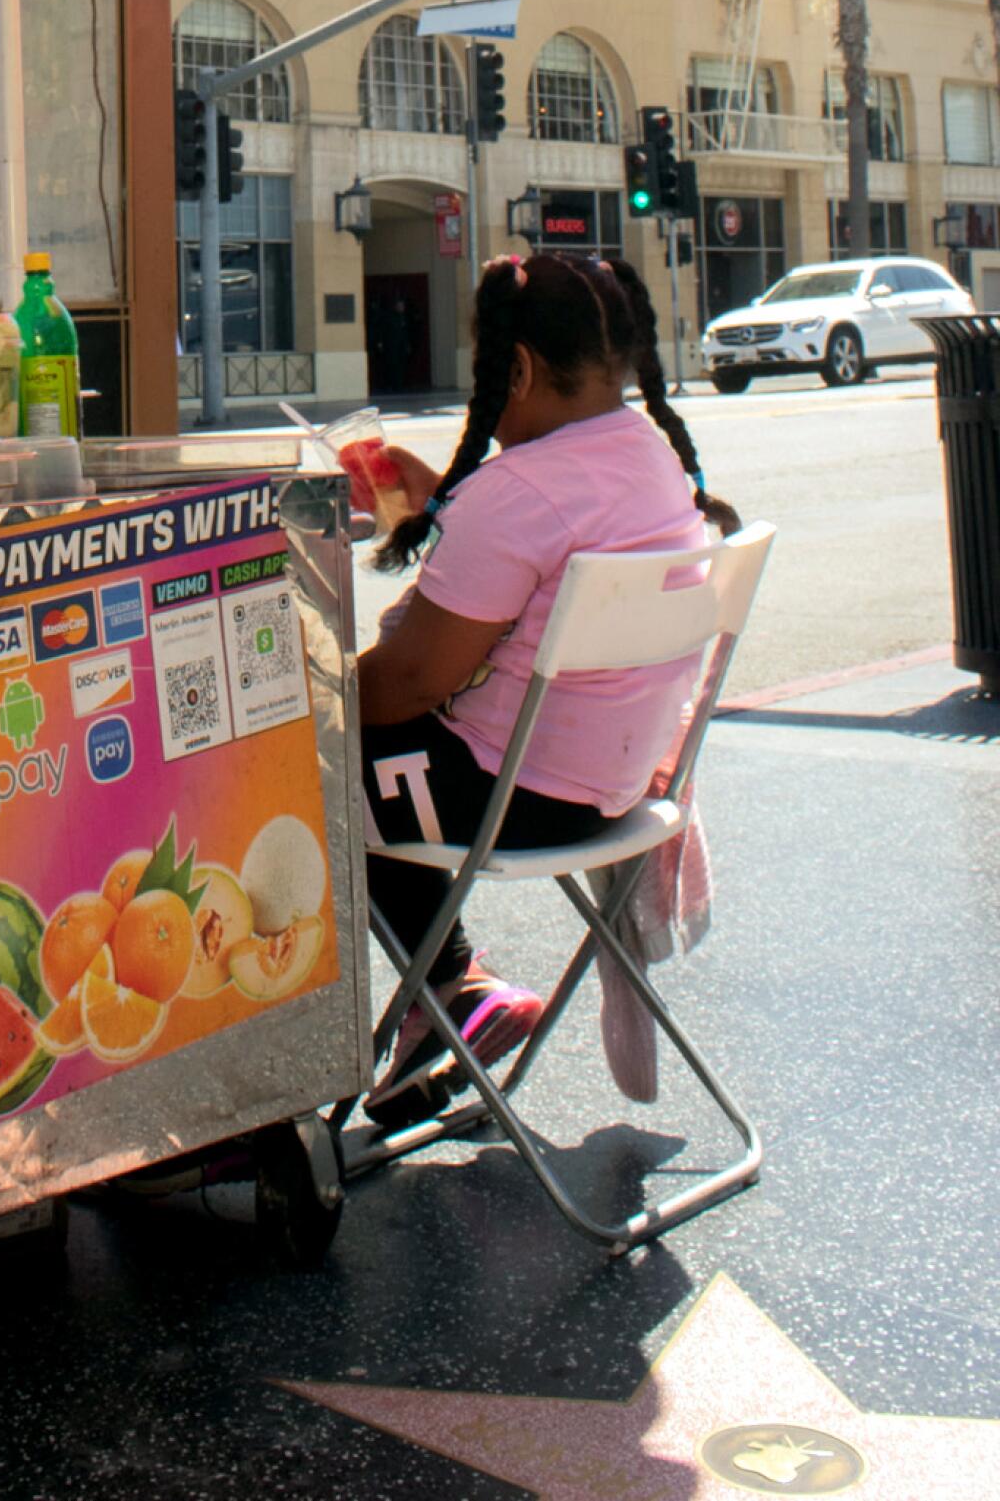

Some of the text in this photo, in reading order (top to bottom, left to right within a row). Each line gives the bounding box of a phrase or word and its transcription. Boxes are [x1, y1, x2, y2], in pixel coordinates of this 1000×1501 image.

[183, 486, 280, 545] WITH:
[224, 560, 262, 586] CASH
[155, 574, 207, 603] VENMO
[41, 618, 88, 638] MasterCard
[76, 664, 126, 690] DISCOVER
[95, 739, 126, 766] pay
